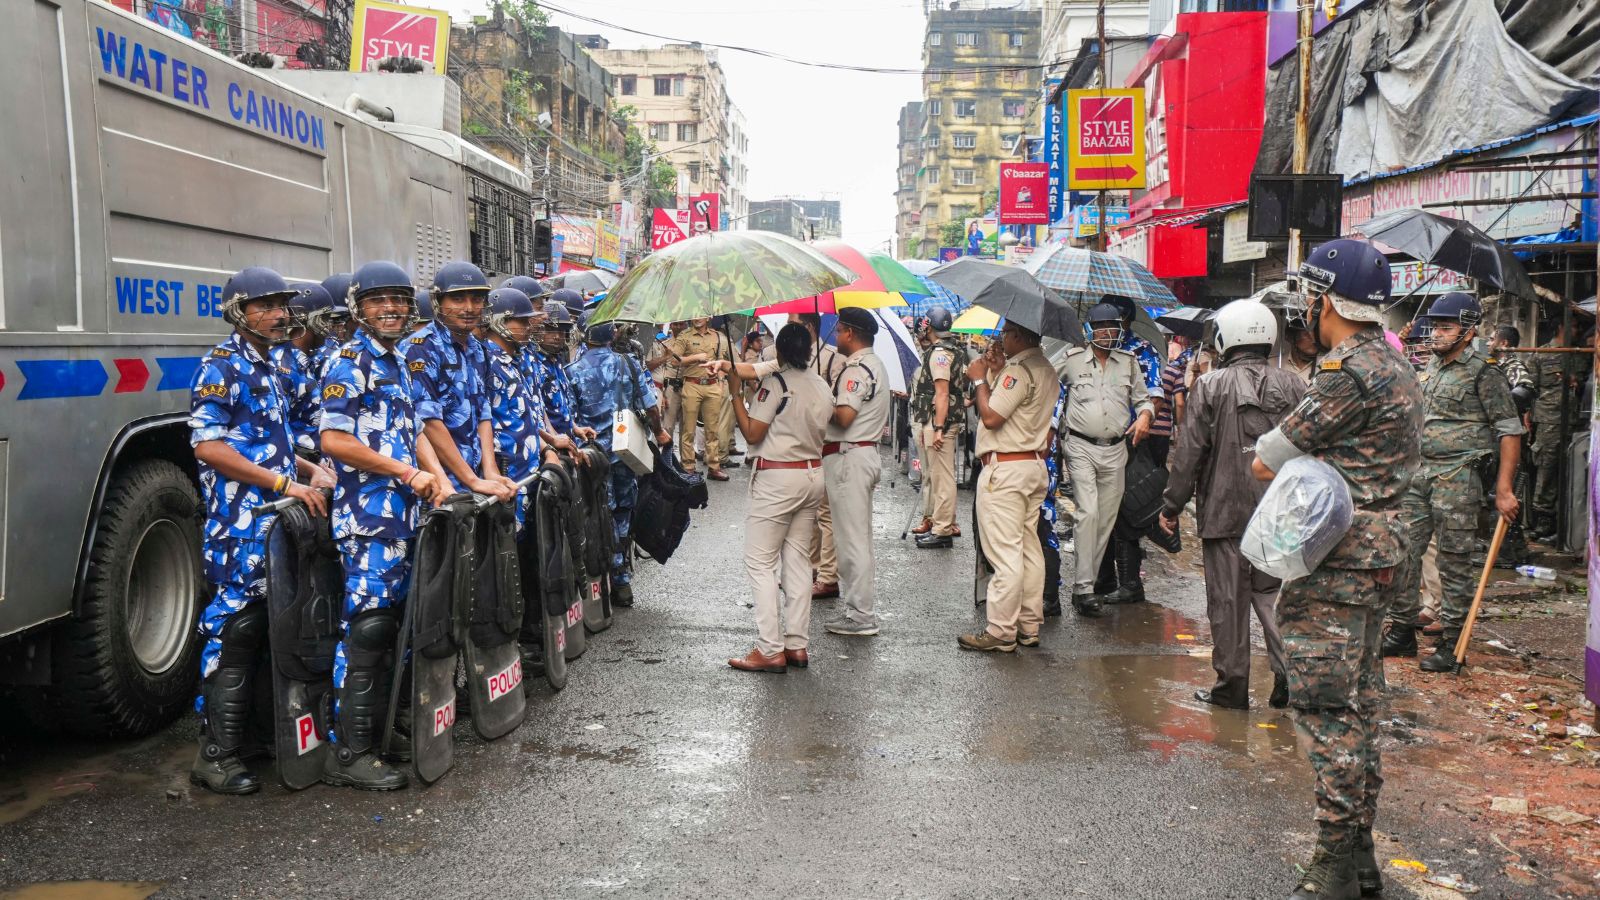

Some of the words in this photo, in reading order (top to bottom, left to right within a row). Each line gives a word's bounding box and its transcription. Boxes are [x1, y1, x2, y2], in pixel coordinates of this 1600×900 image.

[368, 38, 429, 60] STYLE
[96, 27, 210, 109] WATER
[228, 82, 325, 150] CANNON
[1083, 120, 1130, 136] STYLE
[1083, 135, 1130, 148] BAAZAR
[1049, 177, 1059, 213] MART
[1376, 179, 1416, 210] SCHOOL
[1418, 171, 1471, 204] UNIFORM
[115, 277, 184, 316] WEST
